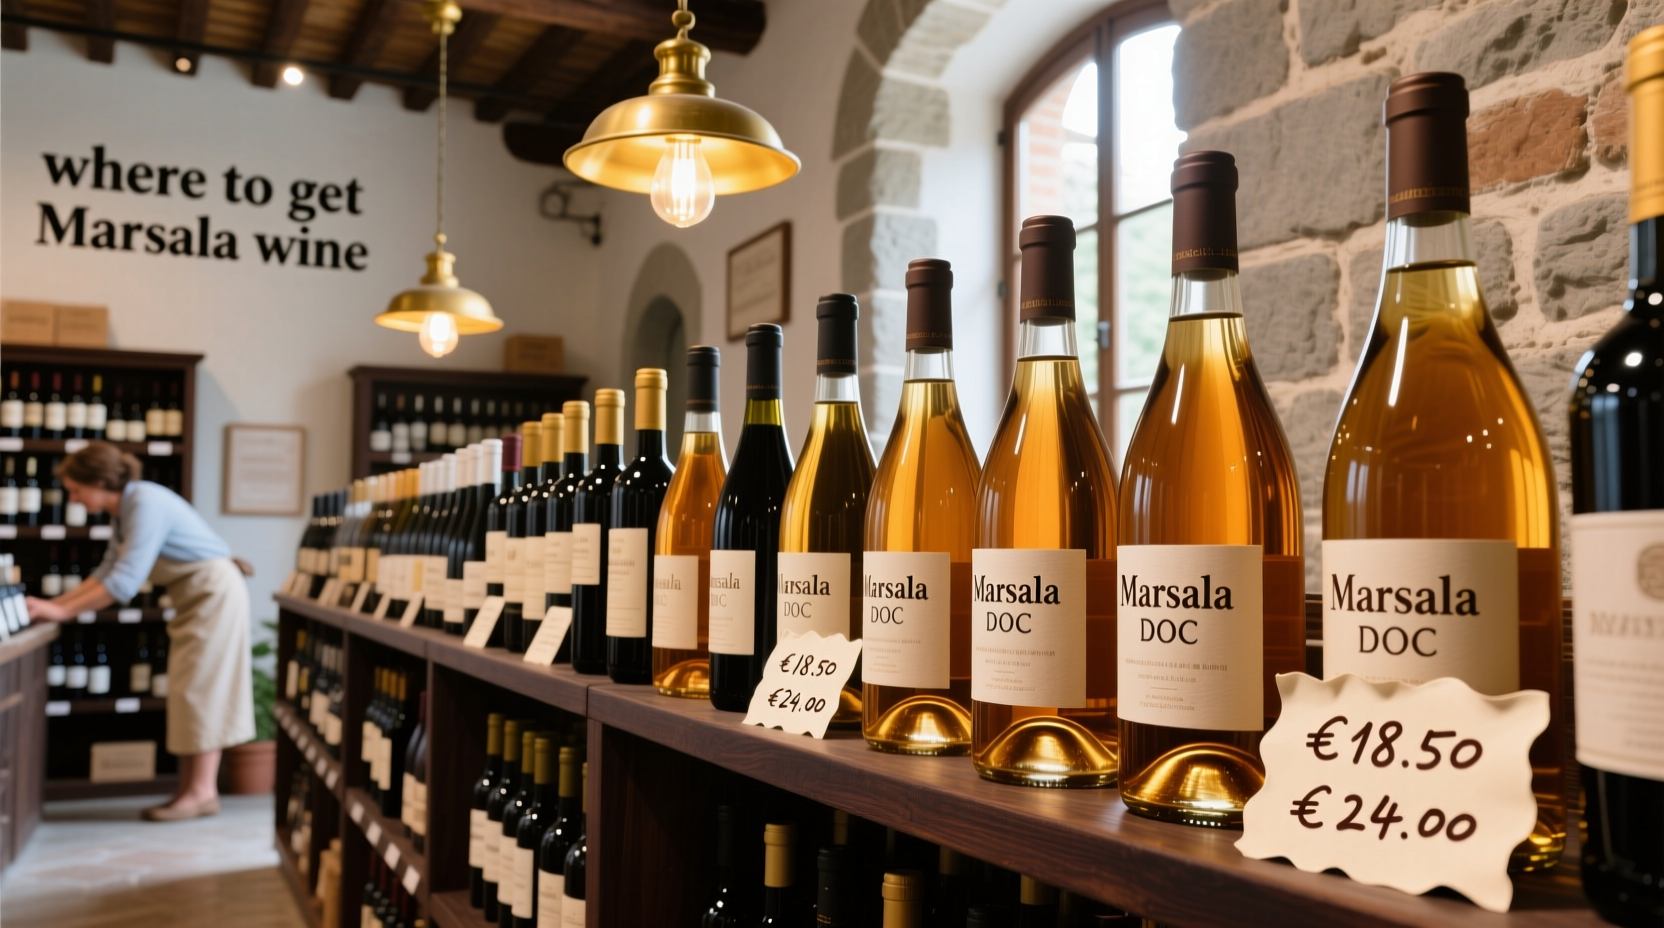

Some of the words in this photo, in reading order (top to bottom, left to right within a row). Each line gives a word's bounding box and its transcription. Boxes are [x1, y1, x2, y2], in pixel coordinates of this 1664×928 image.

[40, 145, 207, 199] where
[223, 165, 273, 207] to
[287, 177, 364, 222] get
[35, 202, 239, 261] Marsala
[253, 225, 369, 272] wine
[974, 574, 1061, 605] Marsala
[1120, 574, 1234, 610] Marsala
[1331, 573, 1480, 616] Marsala
[784, 602, 811, 618] DOC
[871, 606, 903, 625] DOC
[986, 611, 1031, 634] DOC
[1141, 618, 1198, 645] DOC
[1358, 625, 1437, 657] DOC
[778, 652, 837, 678] €18.50
[768, 688, 826, 713] €24.00
[1305, 715, 1484, 771] €18.50
[1290, 785, 1478, 842] €24.00
